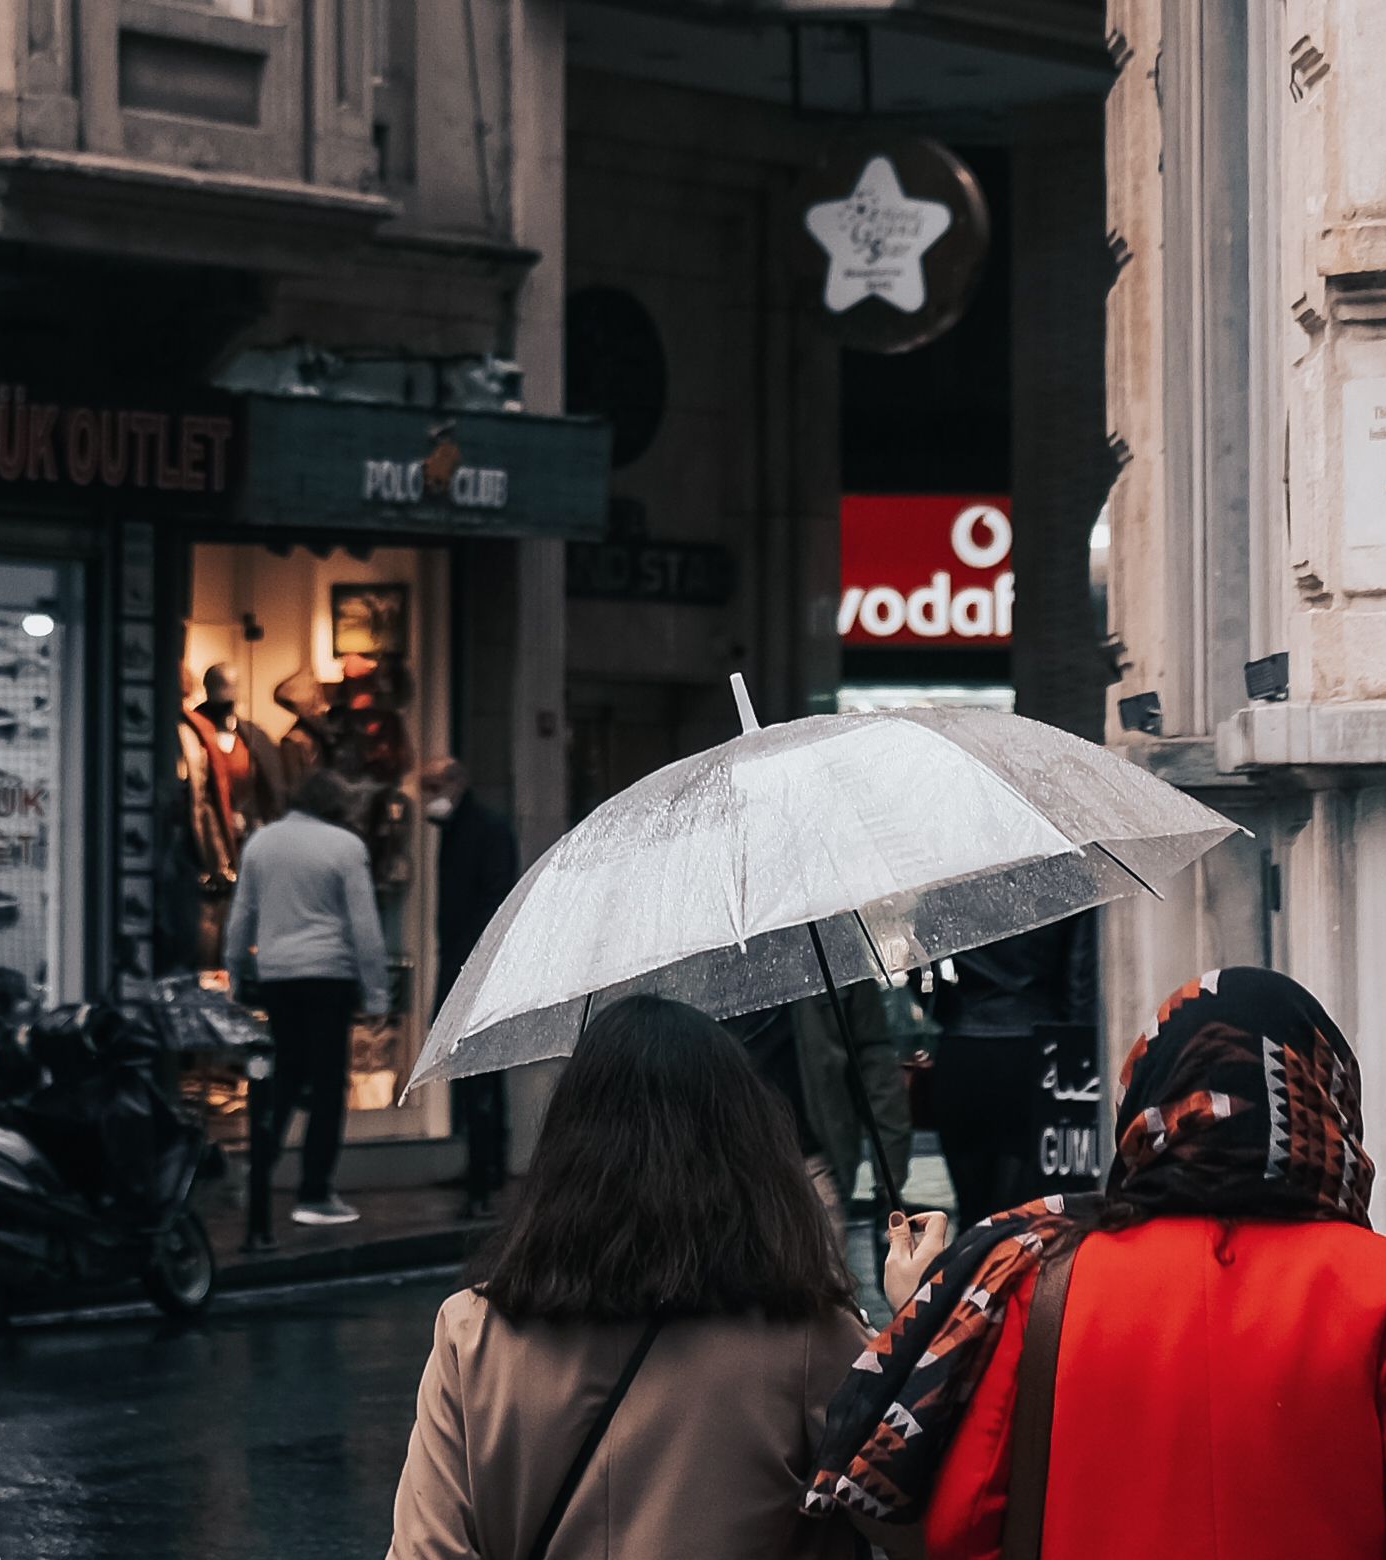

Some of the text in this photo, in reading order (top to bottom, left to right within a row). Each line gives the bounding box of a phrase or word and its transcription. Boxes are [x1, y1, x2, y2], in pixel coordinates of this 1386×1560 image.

[67, 408, 233, 493] OUTLET
[363, 460, 509, 509] POLO CLUB
